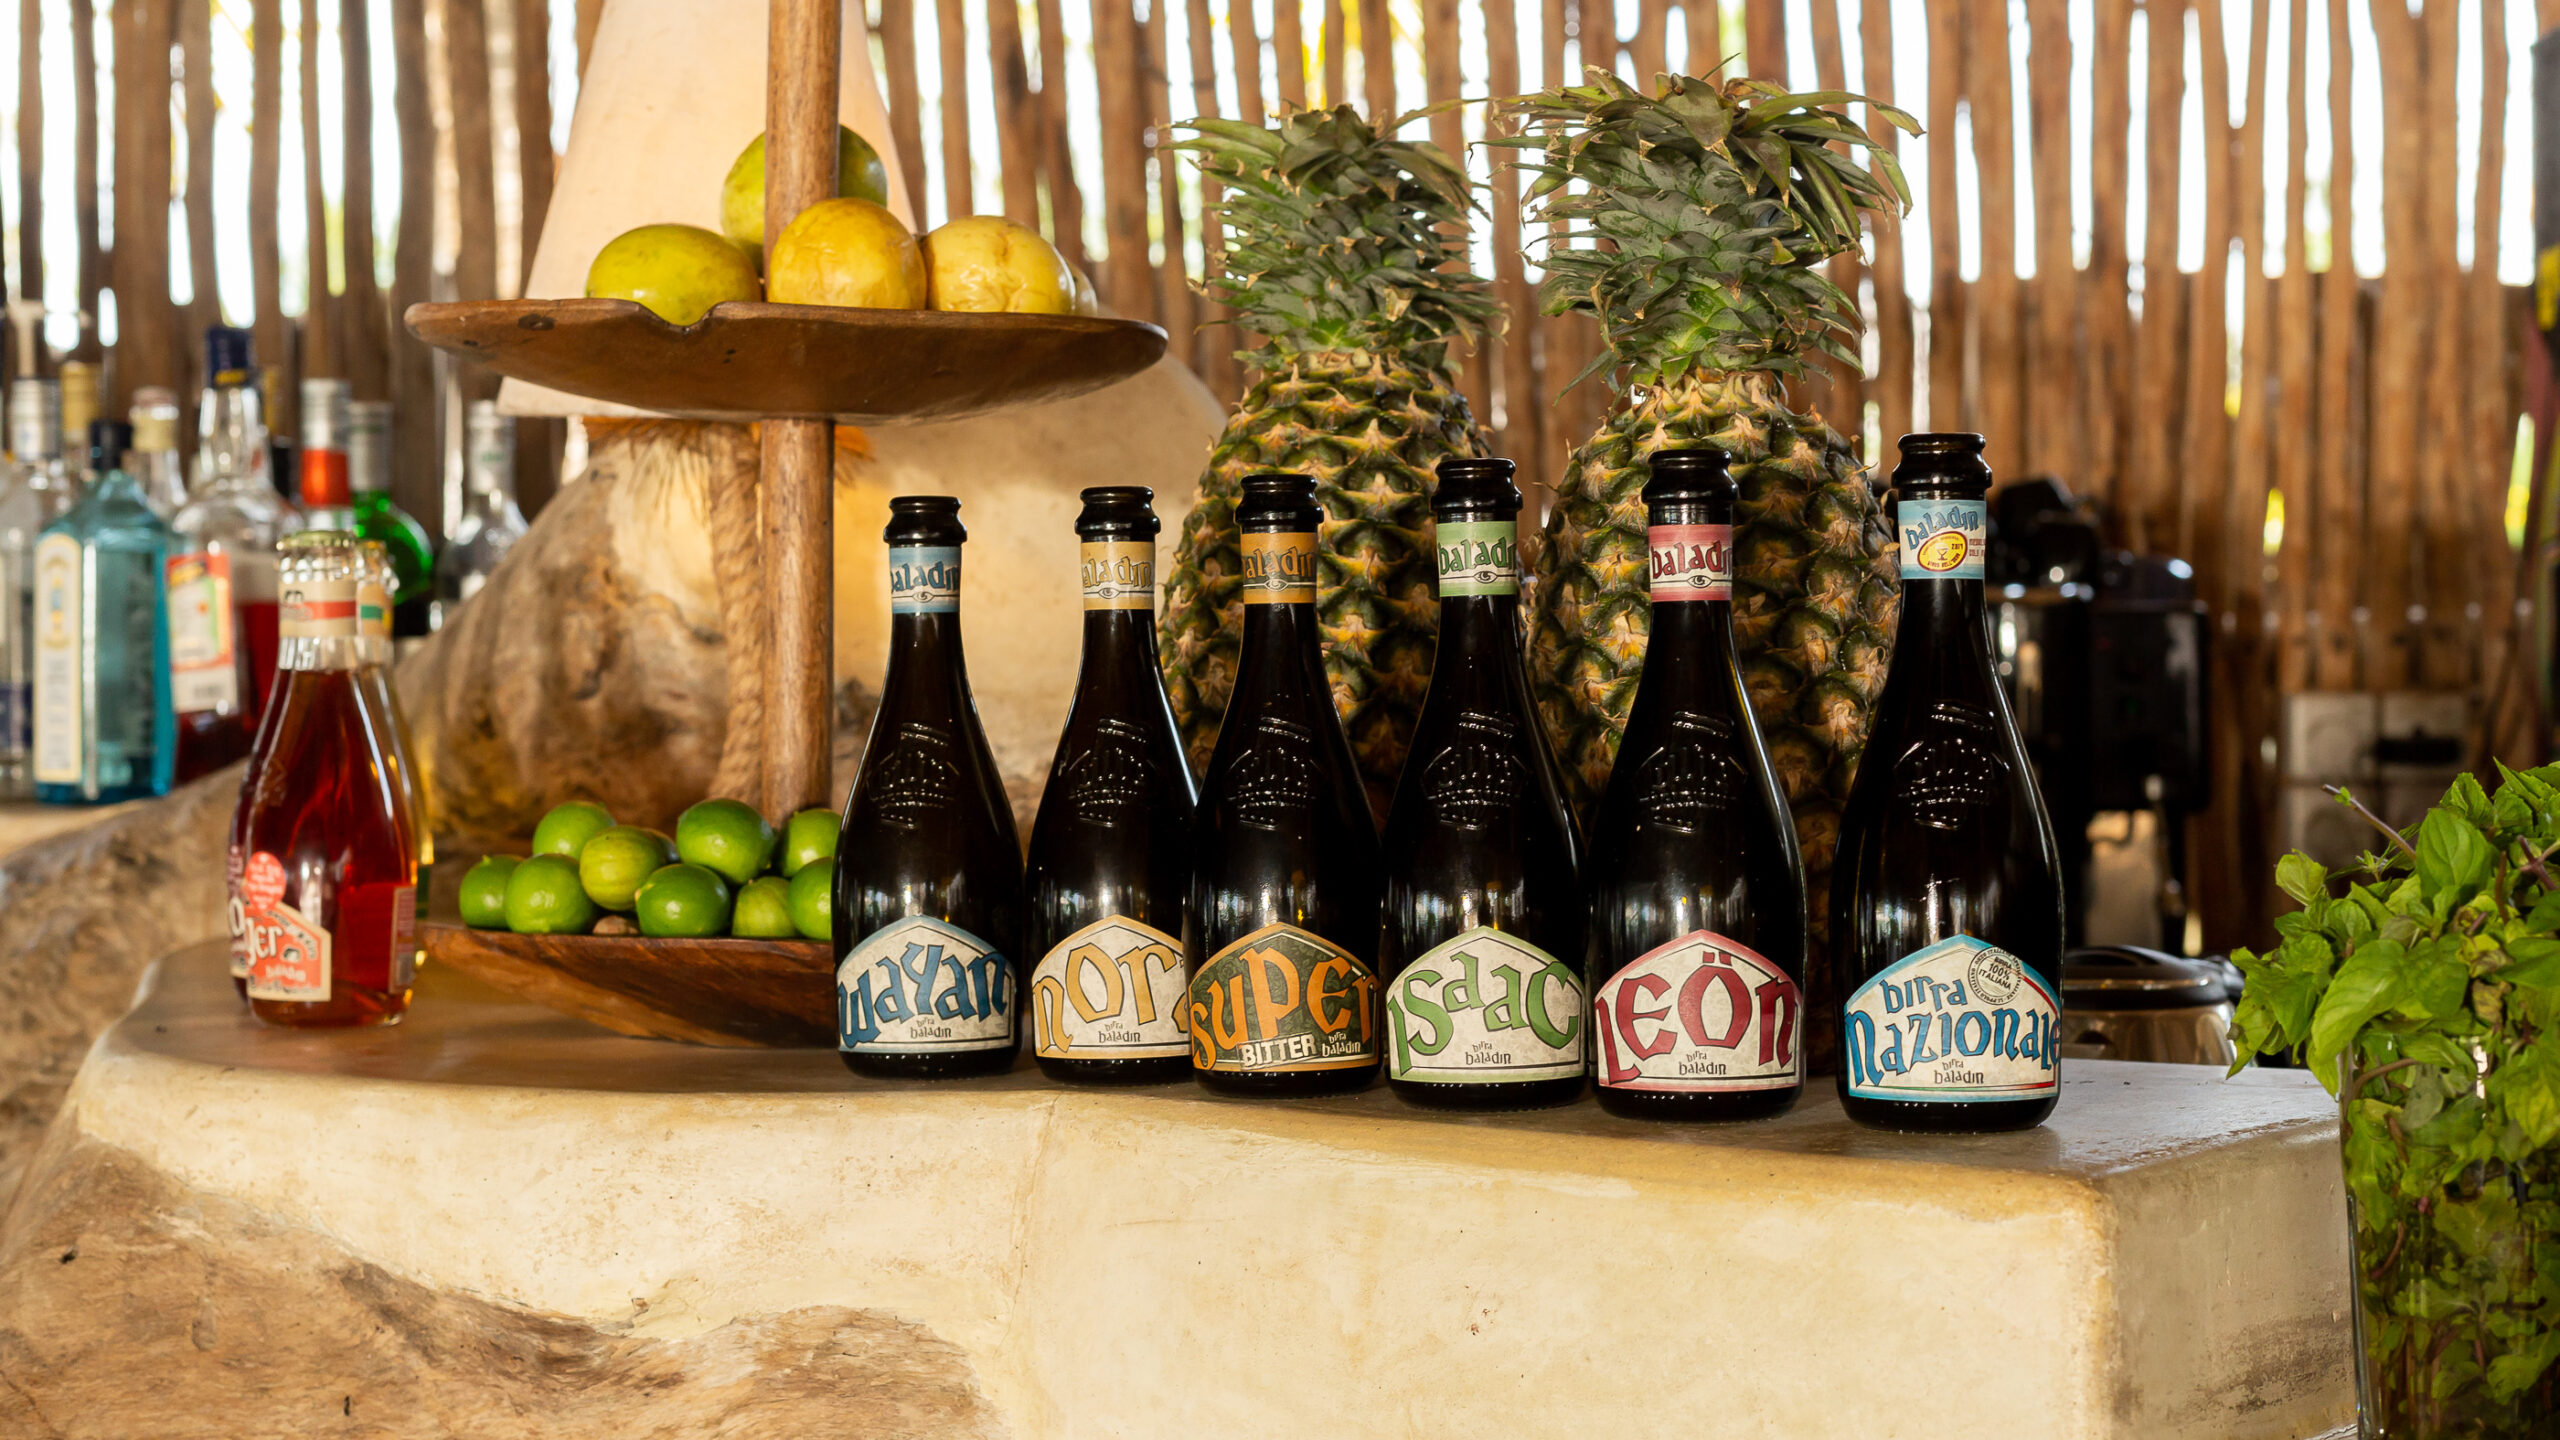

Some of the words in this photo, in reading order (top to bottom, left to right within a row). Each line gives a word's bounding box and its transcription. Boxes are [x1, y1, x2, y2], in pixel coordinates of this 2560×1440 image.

[1905, 506, 1980, 551] baladin
[1083, 555, 1153, 589] aladin
[1994, 956, 2012, 969] BIRRA
[1979, 969, 2011, 990] ITALIANA
[1989, 963, 2011, 980] 100%
[1878, 974, 1969, 1014] birra
[917, 1014, 936, 1028] birra
[1104, 1020, 1124, 1032] birra
[909, 1025, 952, 1040] baladin
[1098, 1030, 1141, 1045] baladin
[1328, 1032, 1347, 1043] birra
[1241, 1032, 1318, 1068] BITTER
[1321, 1040, 1362, 1058] baladin
[1472, 1040, 1493, 1052] birra
[1464, 1049, 1513, 1066] baladin
[1685, 1049, 1708, 1063] birra
[1941, 1058, 1964, 1071] birra
[1678, 1059, 1728, 1076] baladin
[1933, 1068, 1985, 1085] baladin
